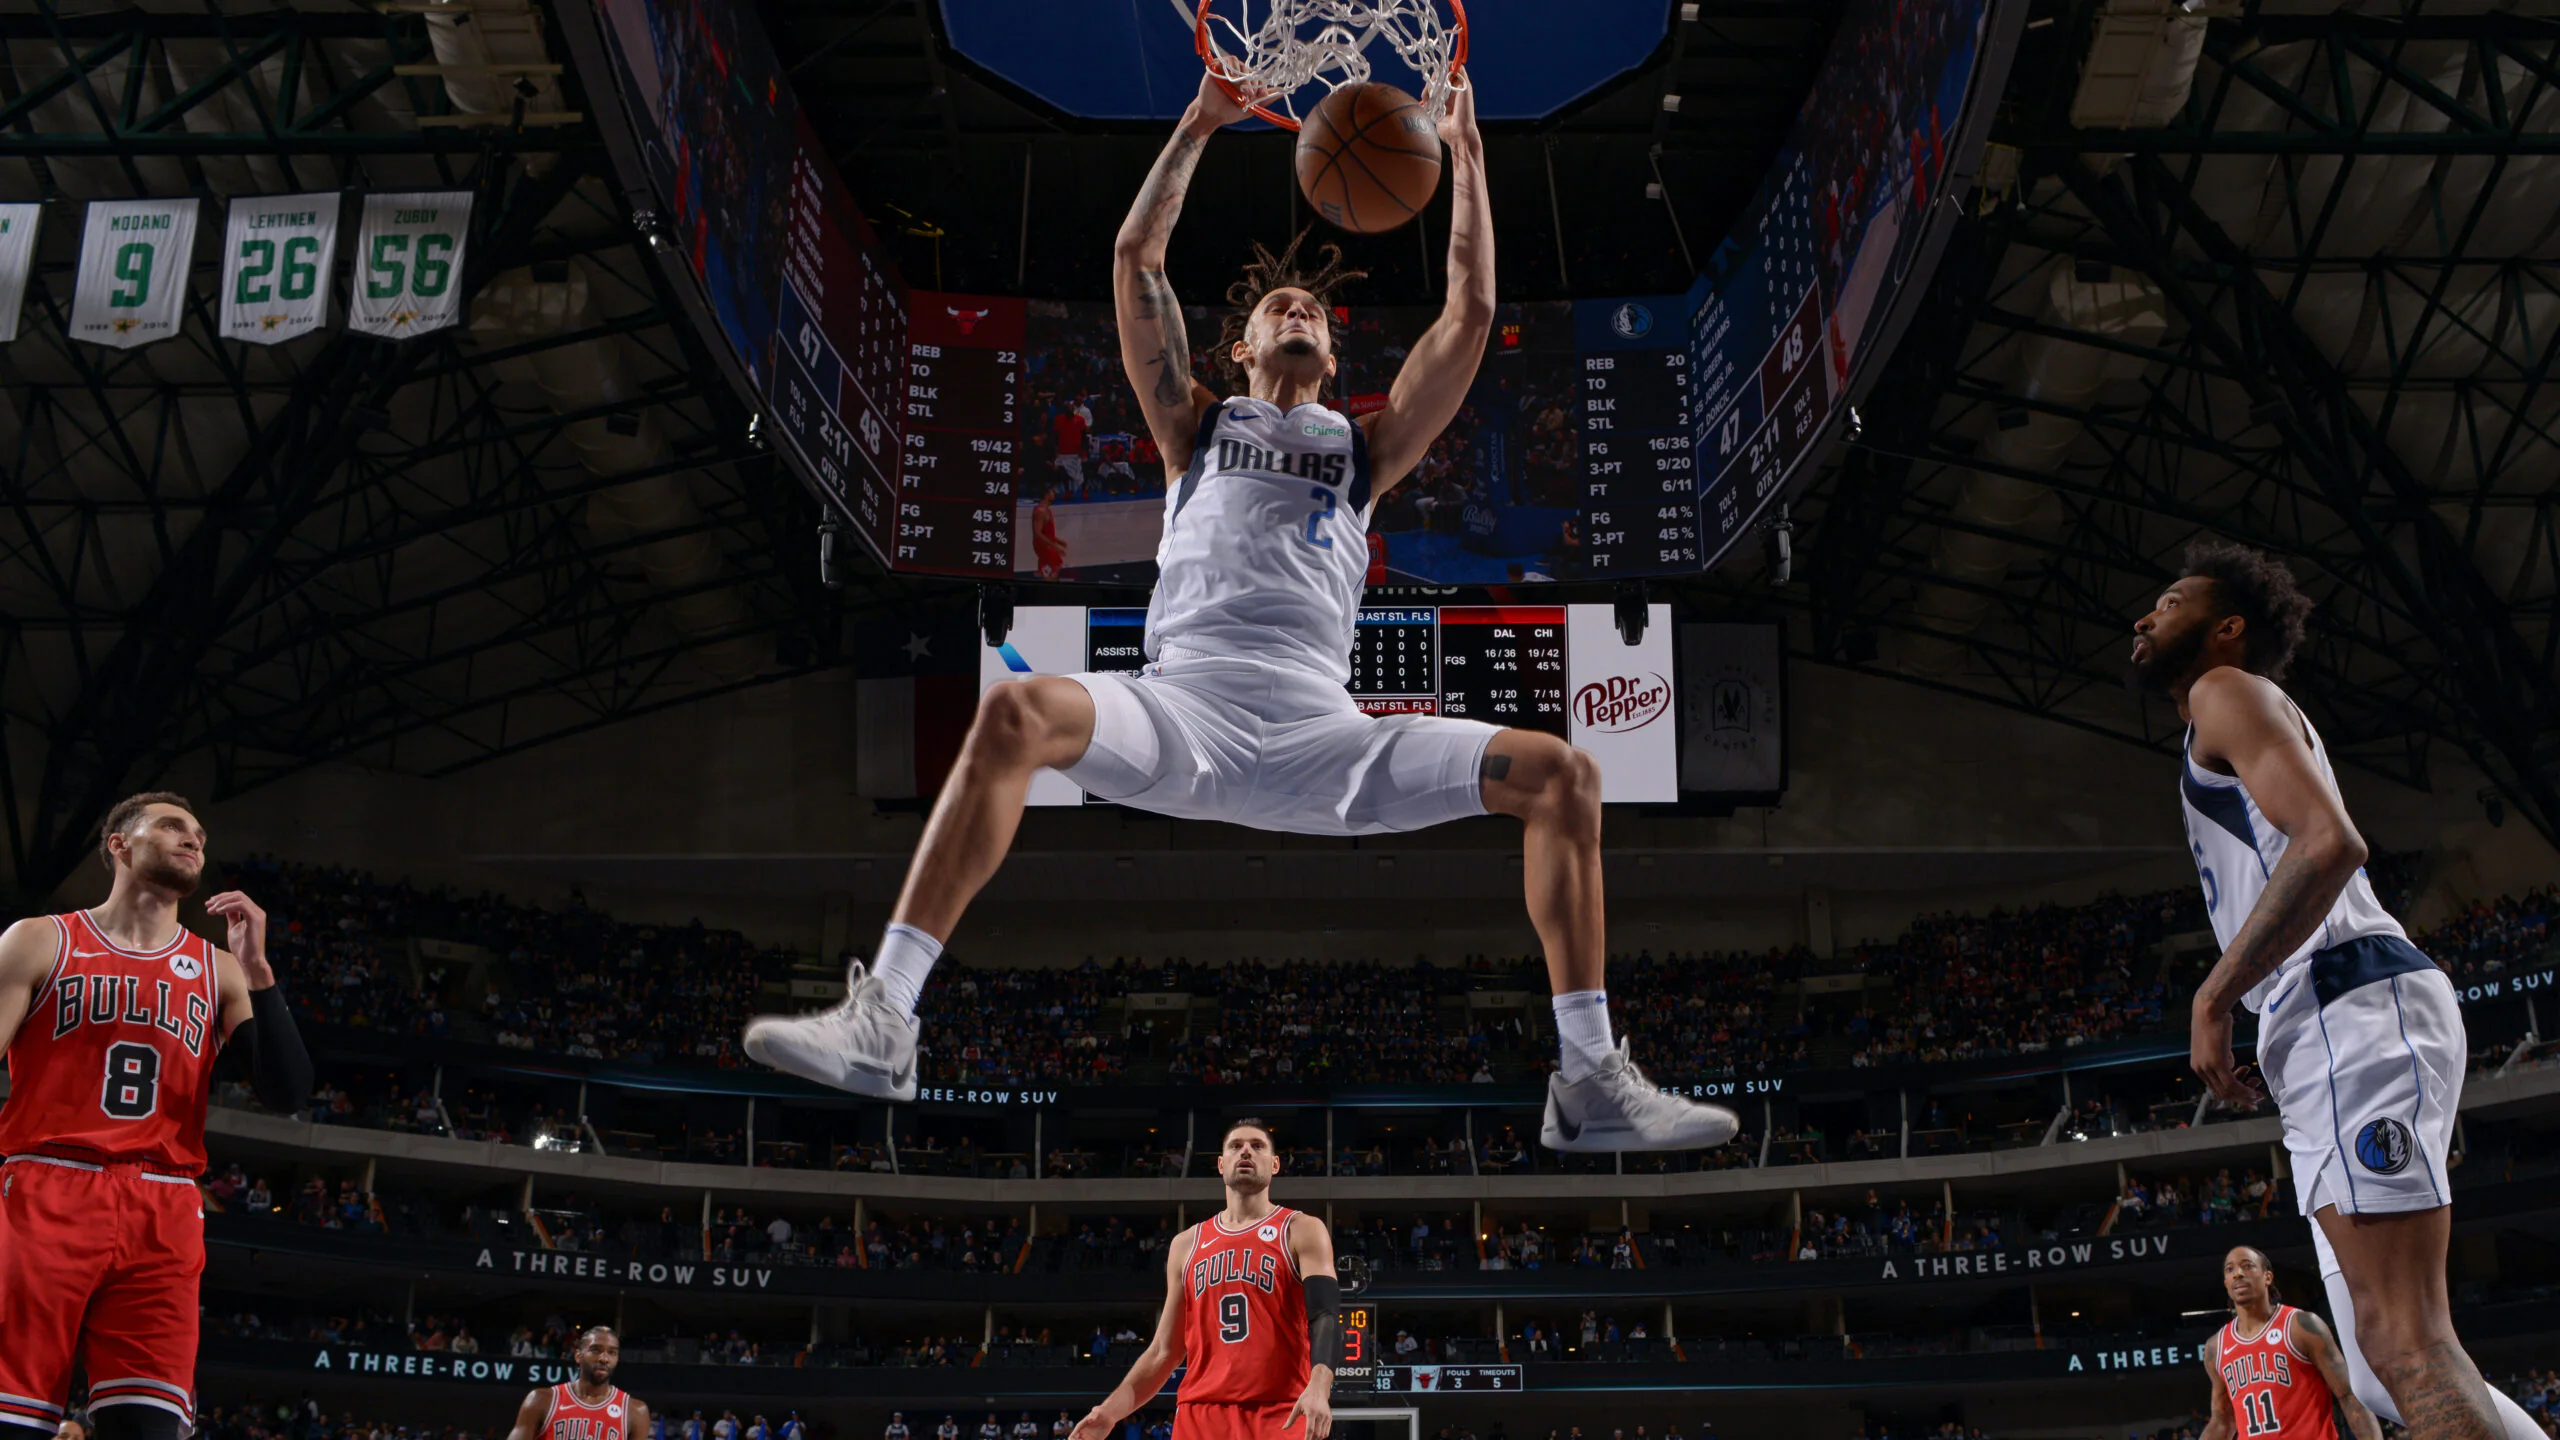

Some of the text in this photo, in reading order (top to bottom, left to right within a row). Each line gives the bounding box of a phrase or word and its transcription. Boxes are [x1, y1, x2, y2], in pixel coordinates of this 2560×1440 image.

[111, 215, 171, 231] MODANO
[250, 211, 316, 229] LEHTINEN
[111, 243, 154, 307] 9
[235, 236, 319, 304] 26
[367, 234, 453, 298] 56
[1700, 306, 1719, 341] LIVELY
[800, 321, 821, 368] 47
[1701, 316, 1731, 361] WILLIAMS
[912, 343, 1016, 364] REB 22
[1782, 324, 1803, 374] 48
[1586, 354, 1685, 370] REB 20
[1703, 350, 1723, 383] GREEN
[911, 363, 1015, 384] TO 4
[1587, 374, 1686, 390] TO 5
[909, 385, 1014, 405] BLK 2
[1588, 395, 1687, 411] BLK 1
[1694, 402, 1703, 418] 55
[1705, 374, 1724, 405] JONES
[789, 404, 800, 429] FLS
[908, 403, 1013, 423] STL 3
[1588, 413, 1688, 430] STL 2
[1696, 389, 1730, 439] 77 DONCIC
[860, 408, 880, 455] 48
[1304, 424, 1344, 436] chime
[1720, 407, 1740, 456] 47
[1796, 409, 1813, 440] FLS 3
[820, 410, 849, 467] 2:11
[906, 434, 1012, 453] FG 19/42
[1589, 437, 1689, 455] FG 16/36
[1750, 416, 1780, 476] 2:11
[904, 454, 1011, 474] 3-PT 7/18
[1218, 439, 1347, 487] DALLAS
[1590, 457, 1691, 475] 3-PT 9/20
[1775, 458, 1782, 475] 2
[840, 479, 846, 498] 2
[903, 475, 1009, 495] FT 3/4
[1591, 479, 1692, 496] FT 6/11
[901, 504, 920, 517] FG
[973, 509, 992, 523] 45
[1306, 486, 1336, 551] 2
[1591, 513, 1610, 525] FG
[1658, 507, 1677, 519] 44
[1722, 506, 1739, 534] FLS 1
[900, 524, 933, 538] 3-PT
[972, 530, 991, 543] 38
[1592, 532, 1624, 545] 3-PT
[1659, 528, 1678, 540] 45
[898, 545, 916, 559] FT
[972, 552, 990, 565] 75
[1593, 555, 1610, 567] FT
[1660, 550, 1679, 562] 54
[1366, 613, 1386, 621] AST
[1388, 613, 1406, 621] STL
[1412, 613, 1430, 621] FLS
[1494, 629, 1553, 638] DAL CHI
[1096, 648, 1139, 656] ASSISTS
[1355, 642, 1426, 650] 0 0 0 0
[1355, 655, 1427, 663] 3 0 0 1
[1445, 657, 1465, 665] FGS
[1493, 663, 1505, 671] 44
[1537, 663, 1549, 671] 45
[1355, 668, 1427, 676] 0 0 0 1
[1355, 681, 1427, 689] 5 5 1 1
[1607, 676, 1640, 701] Dr
[1367, 702, 1386, 711] AST
[1389, 702, 1407, 711] STL
[1413, 702, 1432, 711] FLS
[1446, 693, 1464, 701] 3PT
[1581, 682, 1663, 727] Pepper
[1445, 704, 1465, 712] FGS
[1494, 704, 1506, 712] 45
[1538, 704, 1550, 712] 38
[2512, 970, 2553, 991] SUV
[53, 974, 208, 1058] BULLS
[101, 1040, 161, 1120] 8
[1746, 1079, 1783, 1093] SUV
[921, 1088, 1057, 1104] REE-ROW SUV
[1882, 1235, 2169, 1279] A THREE-ROW SUV
[476, 1249, 772, 1288] A THREE-ROW SUV
[1194, 1249, 1275, 1300] BULLS
[1219, 1292, 1249, 1343] 9
[1345, 1330, 1361, 1361] 3
[315, 1351, 580, 1383] A THREE-ROW SUV
[2068, 1344, 2205, 1371] A THREE-R
[1335, 1367, 1372, 1376] ISSOT
[2222, 1352, 2292, 1400] BULLS
[1454, 1378, 1462, 1389] 3
[1493, 1378, 1501, 1388] 5
[2243, 1389, 2280, 1436] 11
[554, 1417, 619, 1440] BULLS
